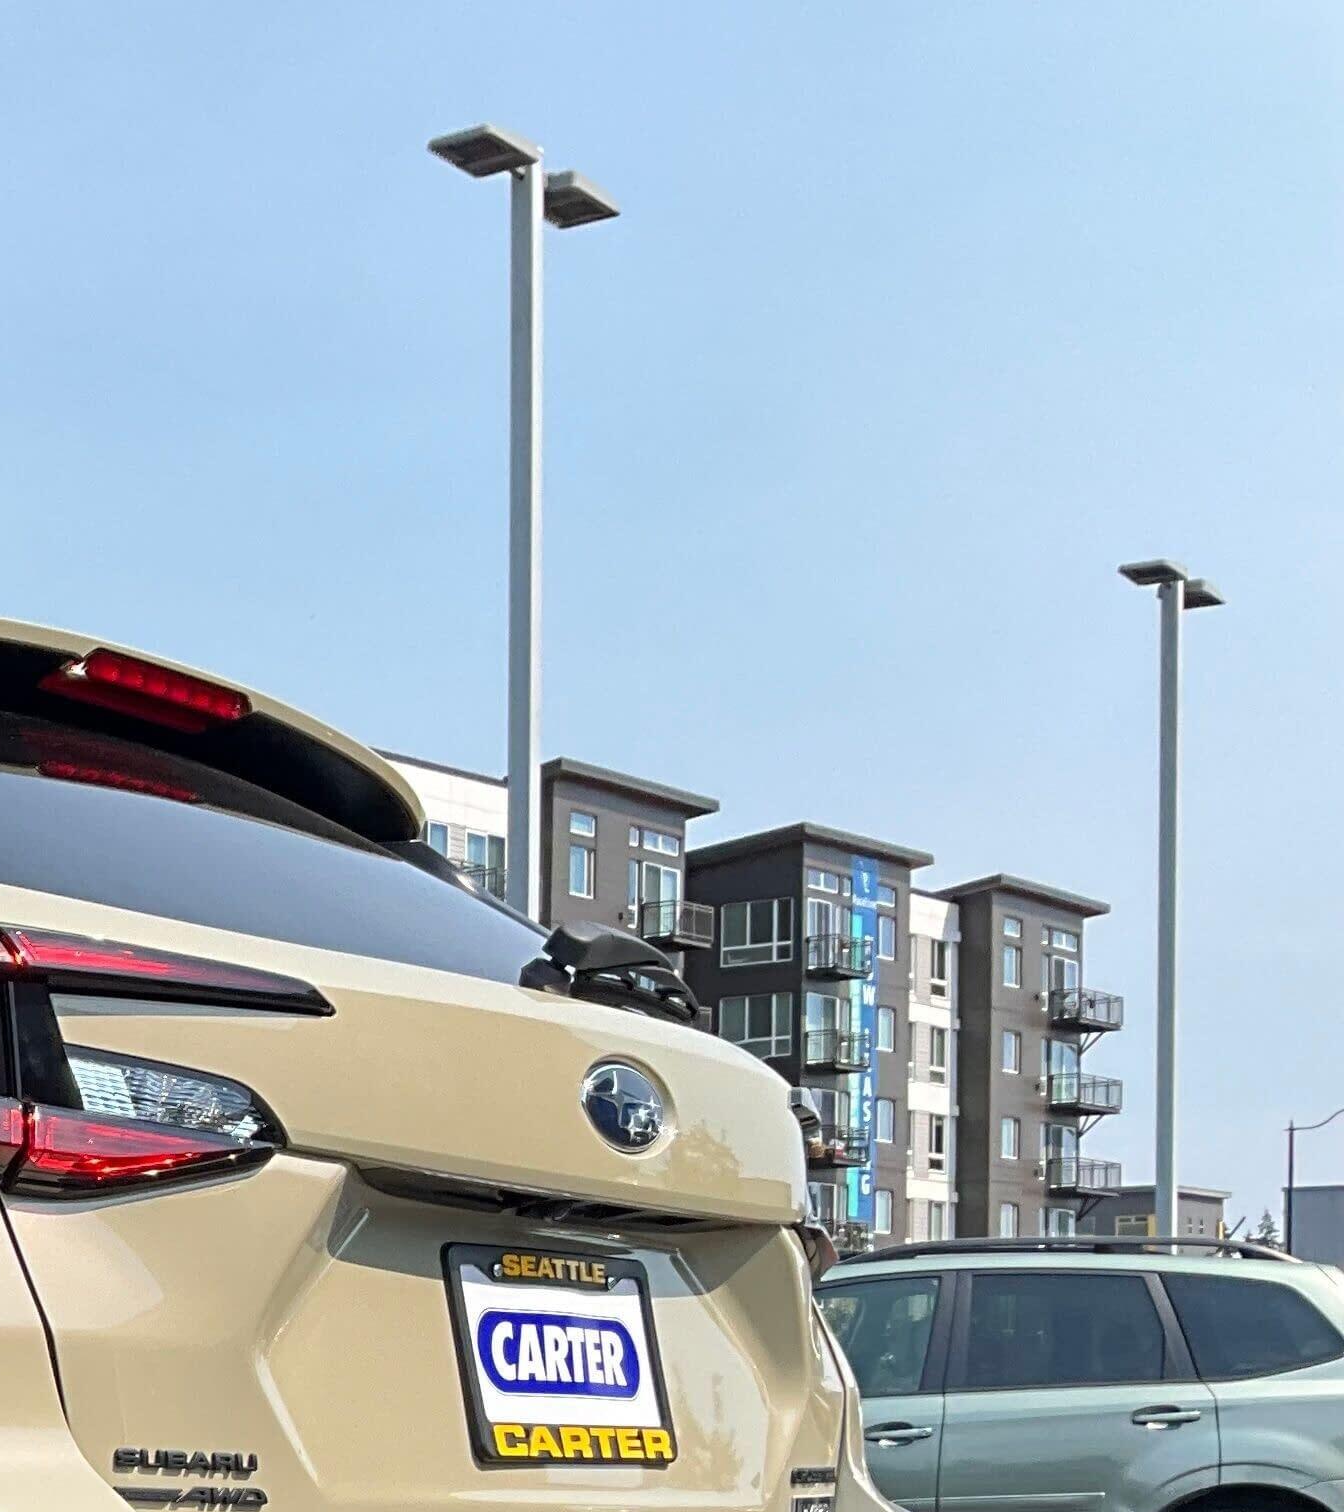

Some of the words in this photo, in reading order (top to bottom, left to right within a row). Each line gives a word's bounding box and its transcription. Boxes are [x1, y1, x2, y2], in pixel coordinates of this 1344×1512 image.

[502, 1253, 607, 1285] SEATTLE
[491, 1321, 628, 1386] CARTER
[493, 1424, 674, 1459] CARTER
[113, 1448, 258, 1472] SUBARU
[177, 1487, 268, 1505] AWD
